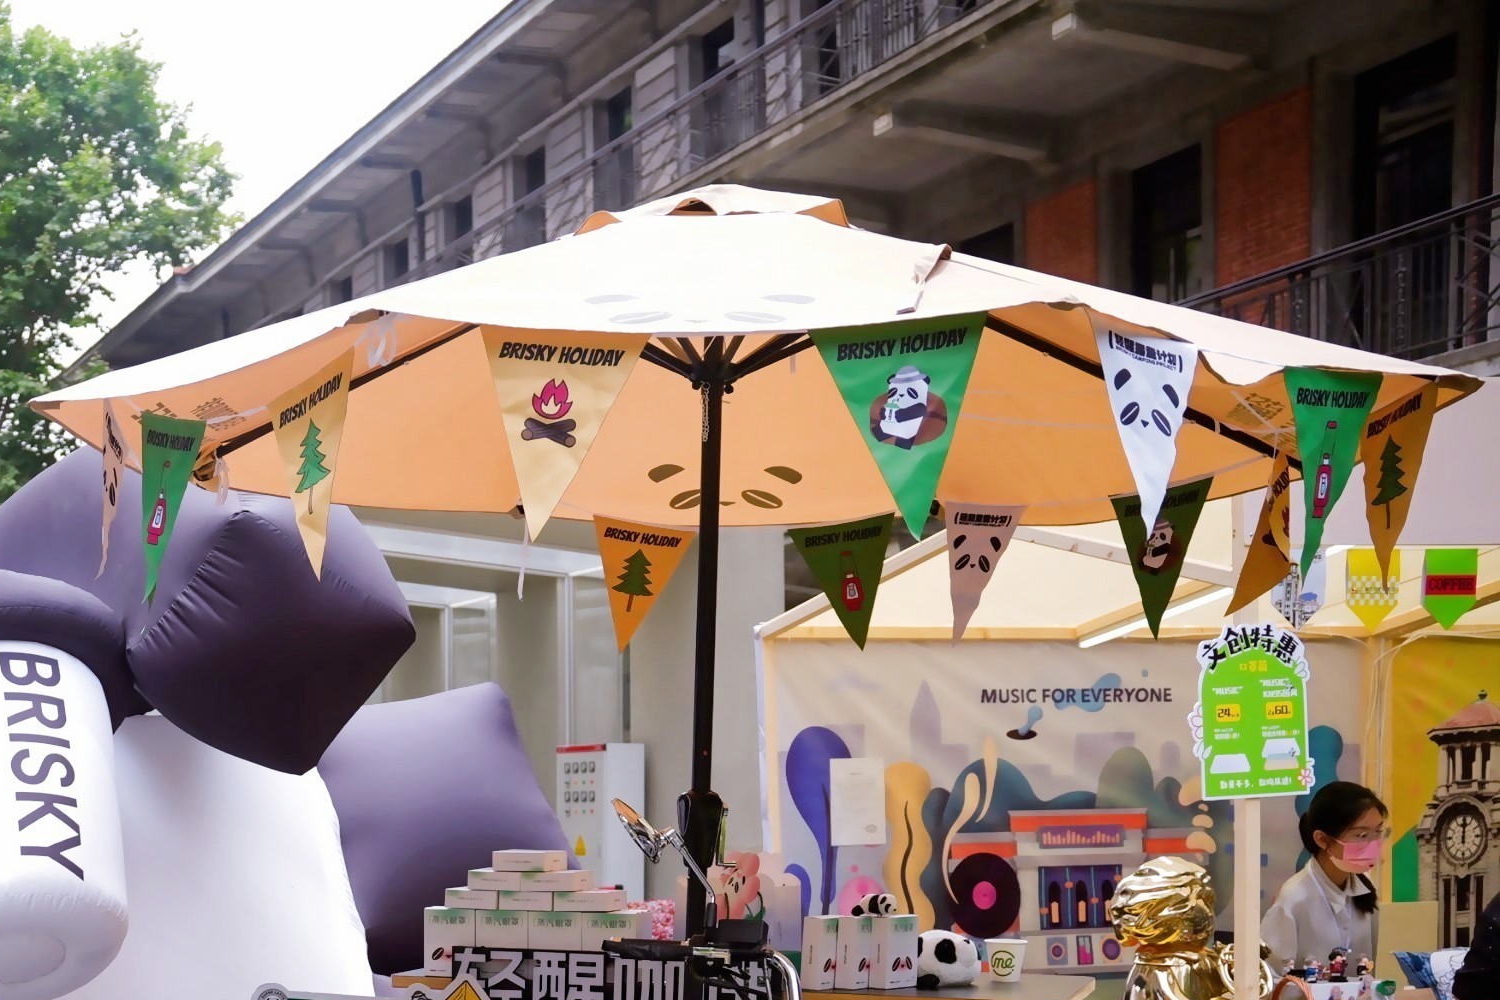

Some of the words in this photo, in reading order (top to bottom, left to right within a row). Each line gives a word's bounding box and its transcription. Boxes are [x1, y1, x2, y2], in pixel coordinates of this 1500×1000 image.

[499, 341, 558, 362] BRISKY
[558, 346, 626, 366] HOLIDAY
[837, 339, 897, 361] BRISKY
[900, 327, 968, 354] HOLIDAY
[278, 399, 308, 429] BRISKY
[308, 372, 343, 411] HOLIDAY
[1297, 387, 1331, 407] BRISKY
[1331, 391, 1370, 408] HOLIDAY
[1367, 416, 1390, 439] BRISKY
[1389, 392, 1422, 425] HOLIDAY
[146, 429, 168, 448] BRISKY
[169, 433, 195, 452] HOLIDAY
[604, 527, 641, 543] BRISKY
[640, 533, 682, 547] HOLIDAY
[804, 532, 841, 548] BRISKY
[842, 526, 883, 543] HOLIDAY
[1429, 577, 1475, 591] COFFEE
[1202, 624, 1299, 670] 文创特惠
[981, 688, 1037, 704] MUSIC
[1042, 688, 1077, 703] FOR
[1081, 688, 1172, 703] EVERYONE
